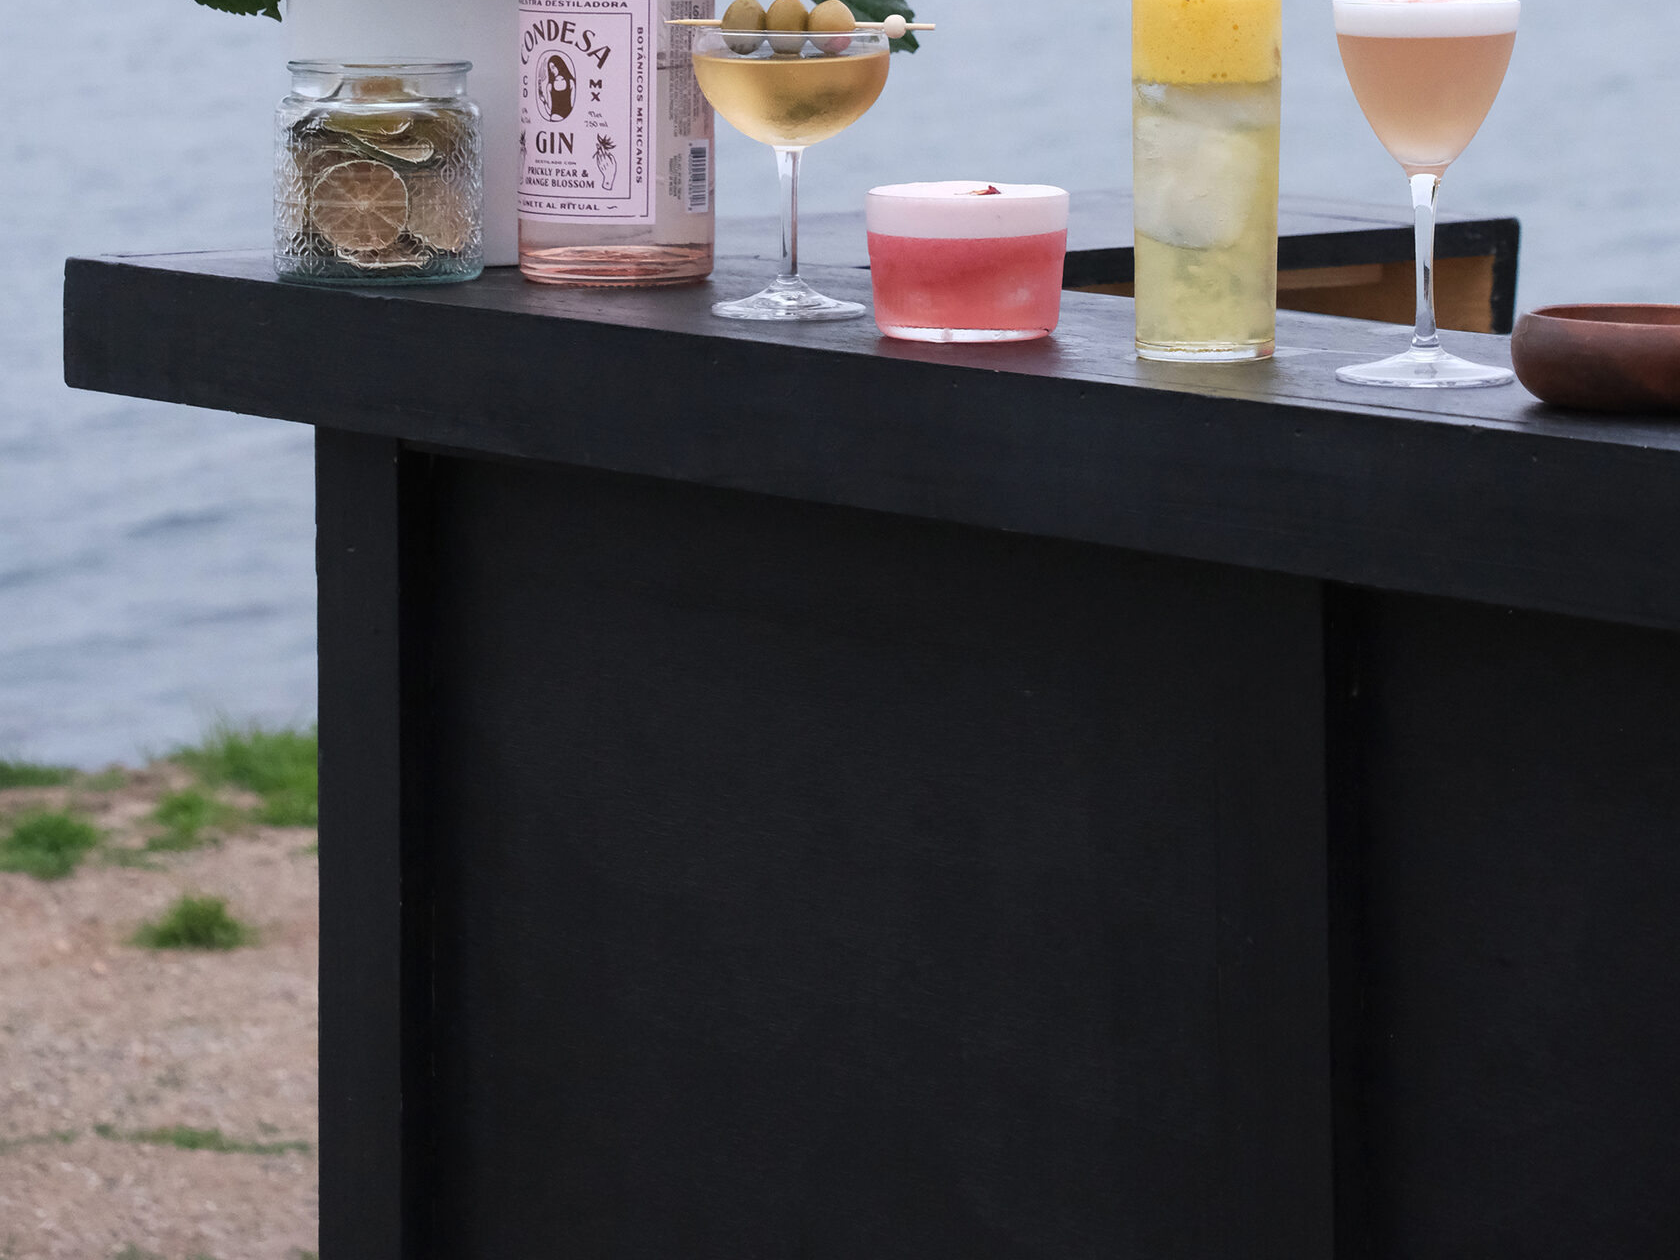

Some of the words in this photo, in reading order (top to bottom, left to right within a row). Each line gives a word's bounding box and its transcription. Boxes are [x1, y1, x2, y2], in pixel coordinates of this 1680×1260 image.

[545, 0, 628, 8] DESTILADORA
[520, 19, 611, 70] CONDESA
[636, 26, 646, 102] BOTÁNICOS
[536, 131, 574, 154] GIN
[636, 107, 644, 184] MEXICANOS
[528, 166, 552, 176] PRICKLY
[556, 168, 578, 178] PEAR
[581, 170, 588, 178] &
[526, 176, 549, 187] ORANGE
[552, 180, 594, 188] BLOSSOM
[546, 201, 557, 210] AL
